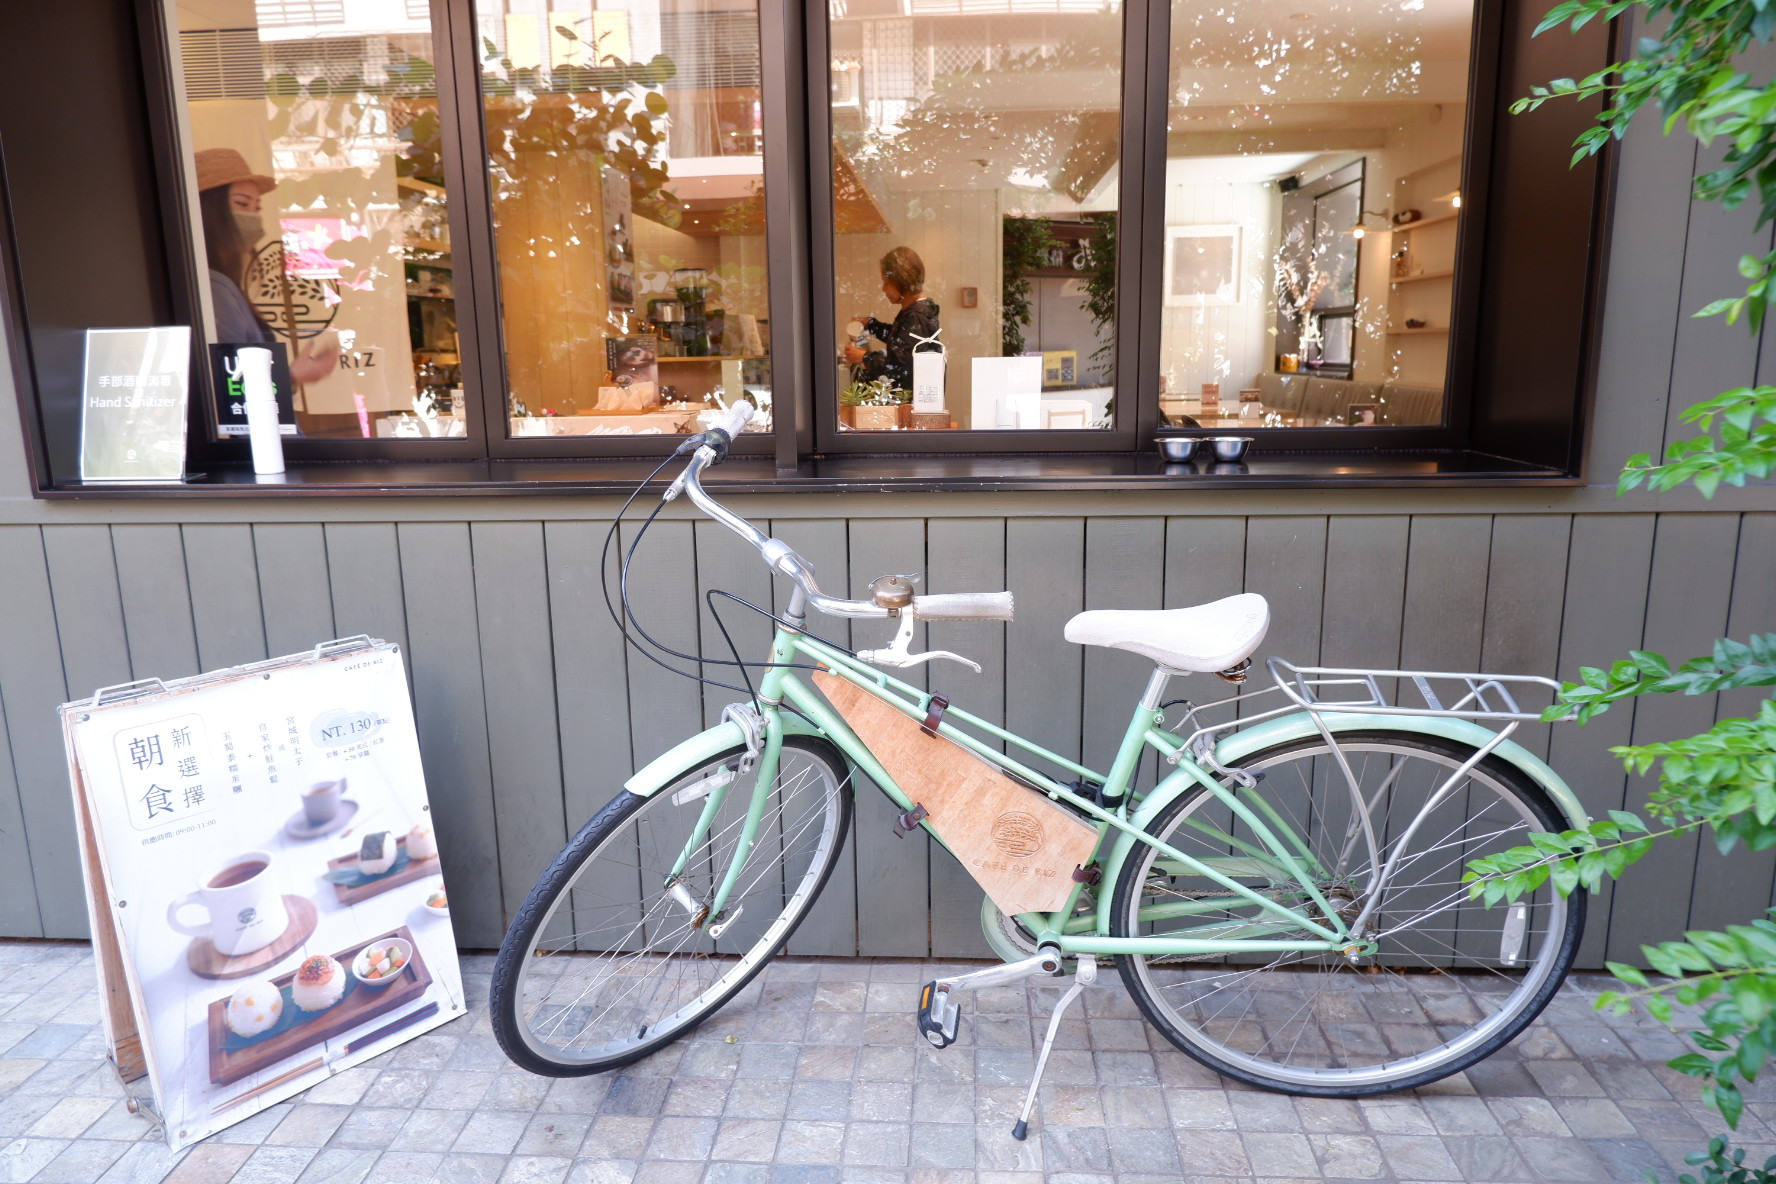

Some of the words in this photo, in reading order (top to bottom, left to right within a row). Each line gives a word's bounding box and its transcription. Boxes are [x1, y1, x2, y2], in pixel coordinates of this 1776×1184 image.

[339, 352, 376, 369] RIZ
[98, 375, 171, 388] 手部酒消毒
[90, 396, 122, 408] Hand
[350, 718, 371, 734] 130
[170, 726, 206, 808] 新選擇
[128, 734, 175, 819] 朝食
[1012, 864, 1029, 874] DE
[1034, 867, 1057, 878] RIZ
